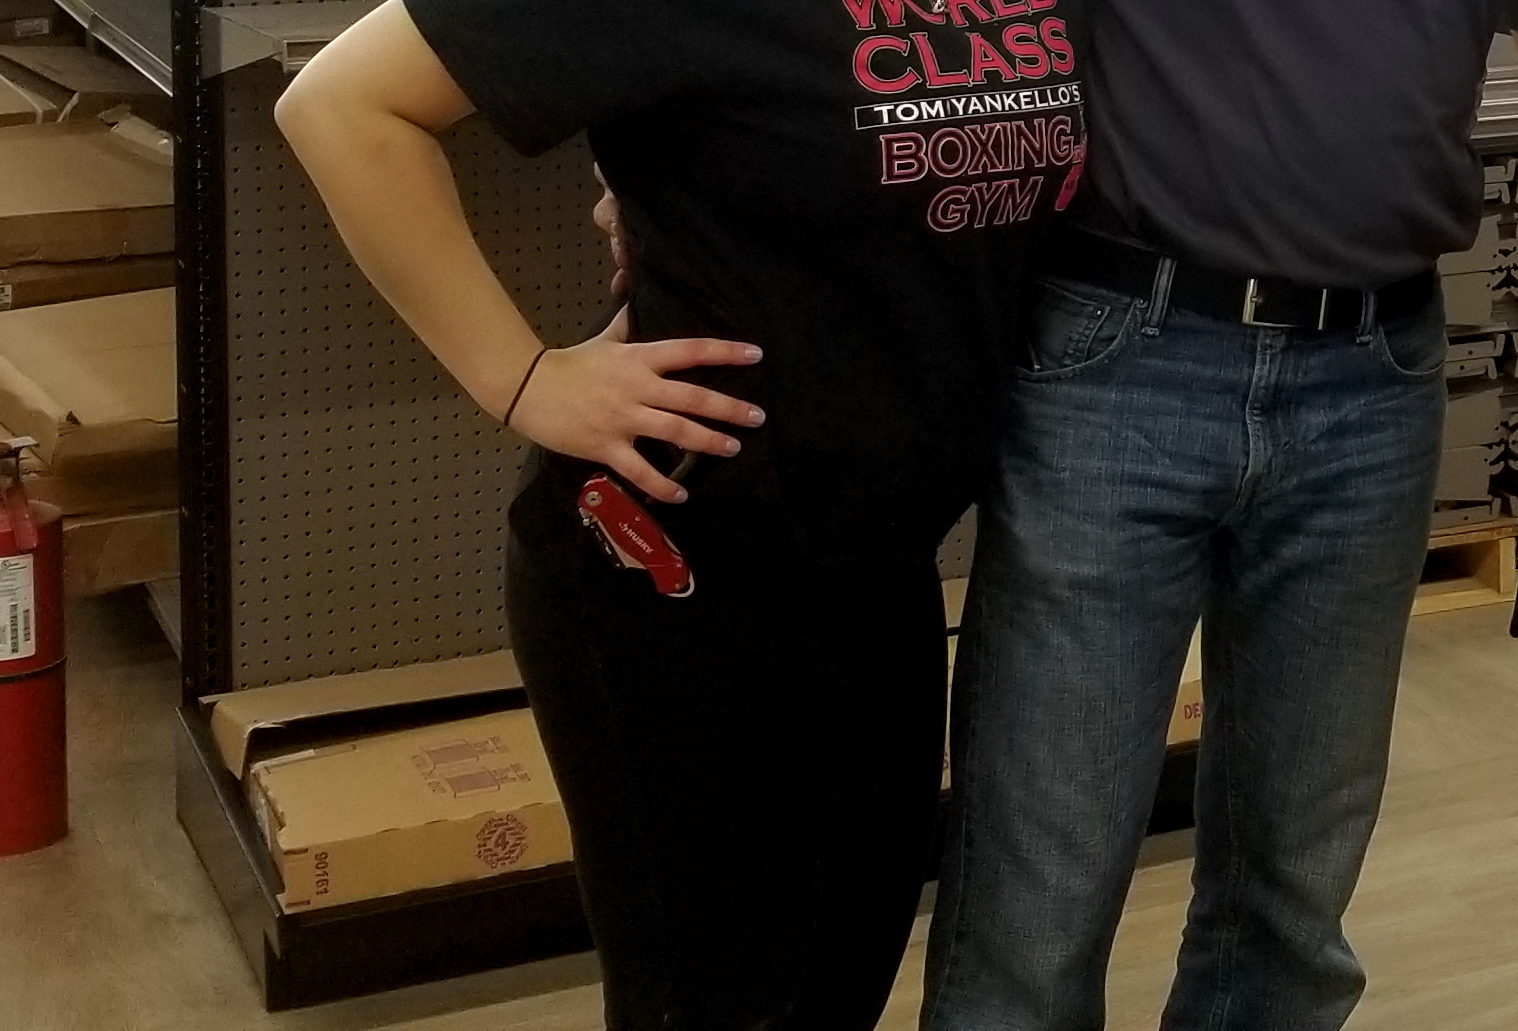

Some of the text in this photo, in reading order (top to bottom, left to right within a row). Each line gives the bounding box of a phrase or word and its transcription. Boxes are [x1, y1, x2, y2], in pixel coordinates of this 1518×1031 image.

[853, 17, 1074, 93] CLASS
[874, 84, 1081, 123] TOM YANKELLO'S
[880, 116, 1074, 184] BOXING
[928, 176, 1043, 232] GYM
[1183, 702, 1203, 719] DE
